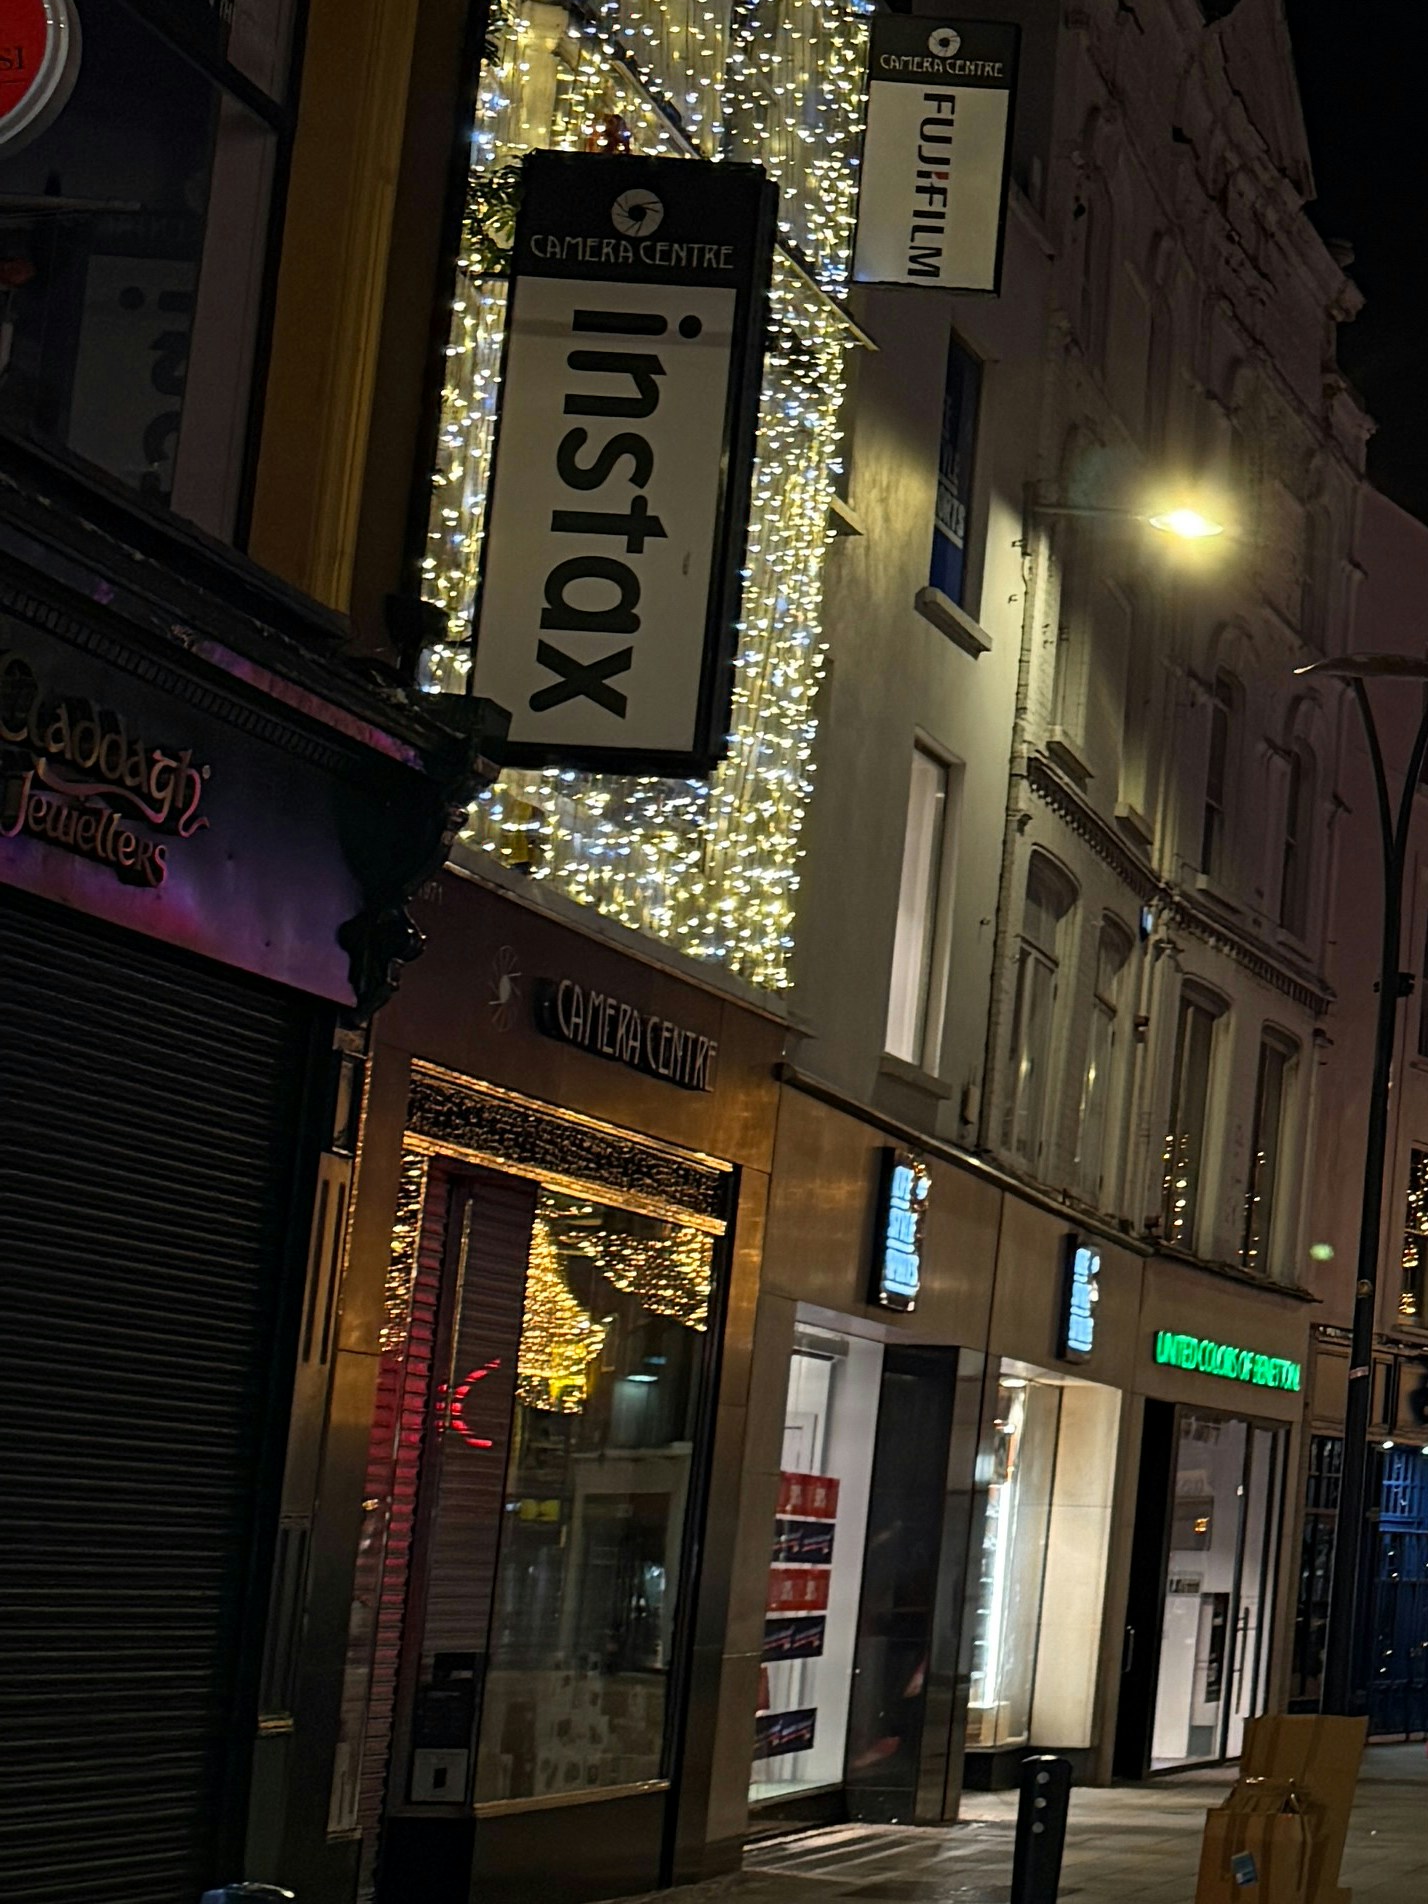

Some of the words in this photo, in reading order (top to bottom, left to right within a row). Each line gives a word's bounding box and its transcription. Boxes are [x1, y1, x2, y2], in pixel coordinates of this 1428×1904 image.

[880, 53, 943, 74] CAMERA
[946, 58, 1003, 78] CENTRE
[907, 93, 956, 278] FUJIFILM
[530, 233, 634, 265] CAMERA
[639, 240, 734, 270] CENTRE
[529, 309, 702, 719] instax
[0, 769, 168, 888] Jewellers
[557, 979, 641, 1065] CAMERA
[647, 1015, 719, 1093] CENTRE
